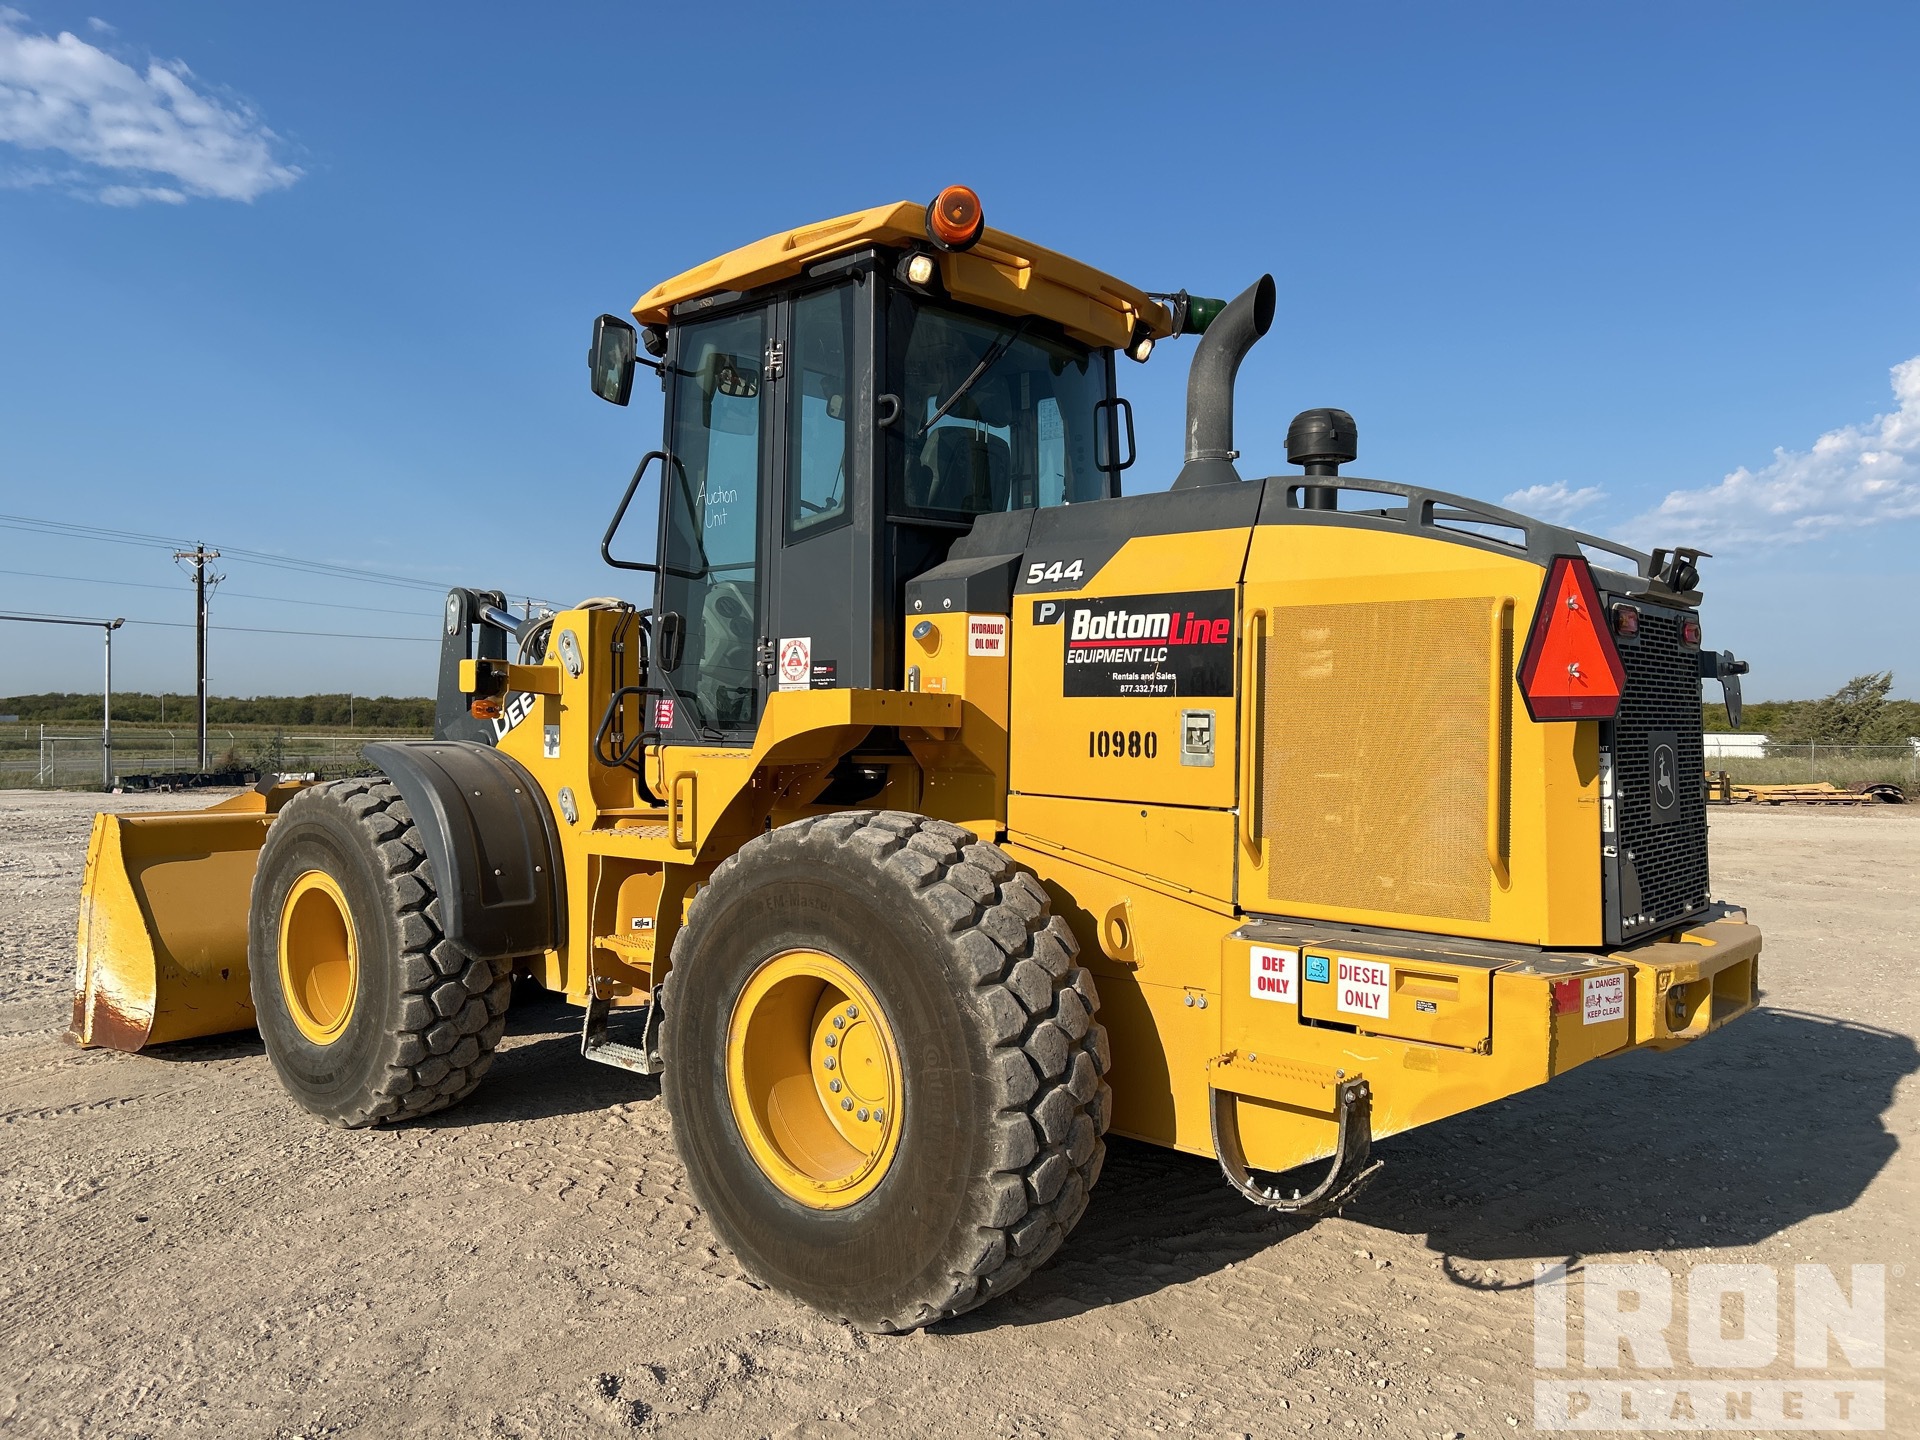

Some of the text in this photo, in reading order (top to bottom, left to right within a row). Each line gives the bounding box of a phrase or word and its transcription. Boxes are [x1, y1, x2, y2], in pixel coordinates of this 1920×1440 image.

[695, 481, 738, 506] Auction
[705, 507, 728, 528] Unit
[1026, 559, 1084, 584] 544
[1039, 602, 1056, 623] P
[971, 623, 1004, 635] HYDRAULIC
[975, 638, 1000, 650] OIL ONLY
[1067, 647, 1168, 664] EQUIPMENT LLC
[1112, 672, 1177, 681] Rentals and Sales
[1120, 684, 1168, 693] 877.332.7187
[491, 692, 537, 742] DEE
[1089, 730, 1157, 758] 10980
[1262, 956, 1285, 972] DEF
[1339, 963, 1388, 986] DIESEL
[1595, 977, 1620, 989] DANGER
[1257, 976, 1290, 994] ONLY
[1345, 989, 1381, 1010] ONLY
[1587, 1007, 1620, 1019] KEEP CLEAR
